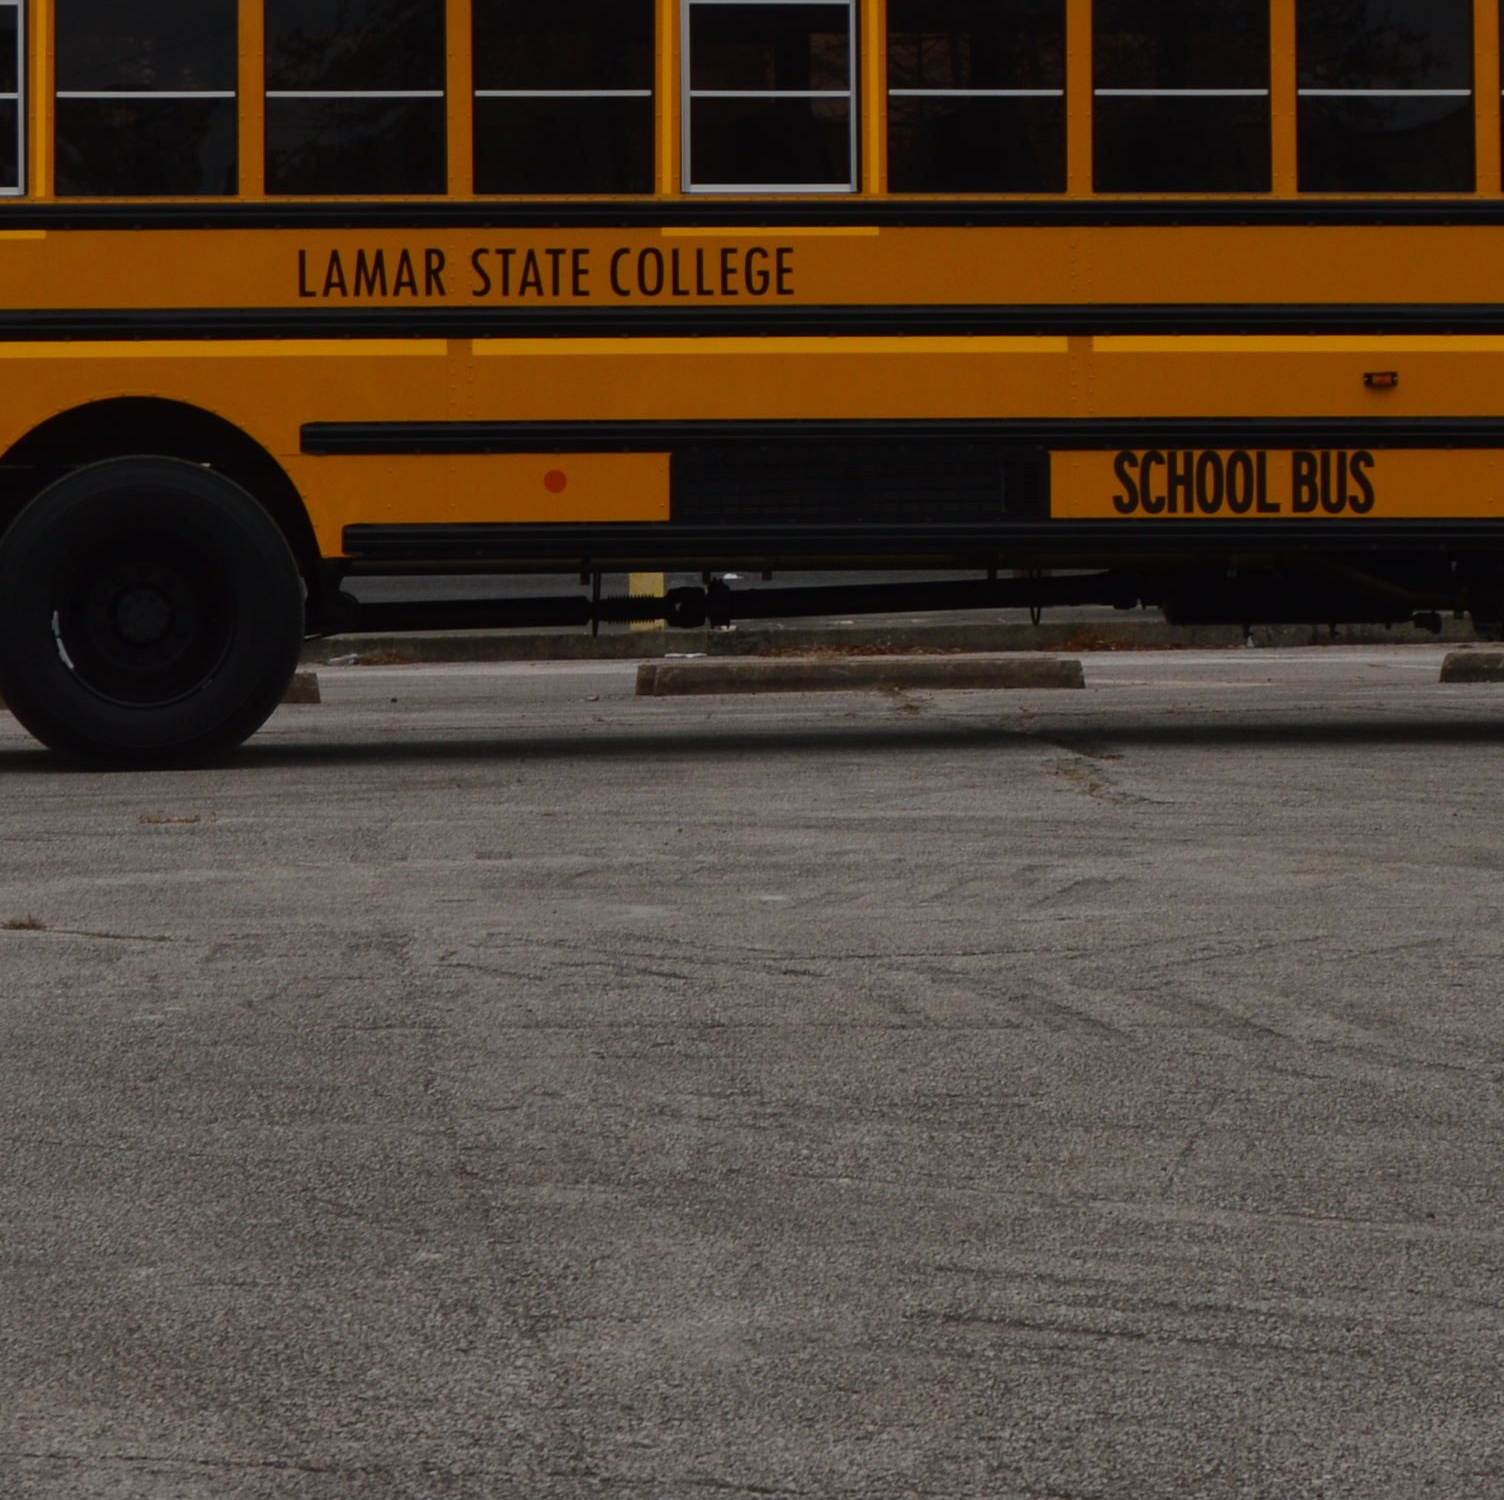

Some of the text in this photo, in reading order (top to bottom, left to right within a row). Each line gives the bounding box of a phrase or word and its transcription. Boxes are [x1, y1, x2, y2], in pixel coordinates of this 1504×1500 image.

[298, 247, 795, 297] LAMAR STATE COLLEGE
[1112, 450, 1375, 514] SCHOOL BUS
